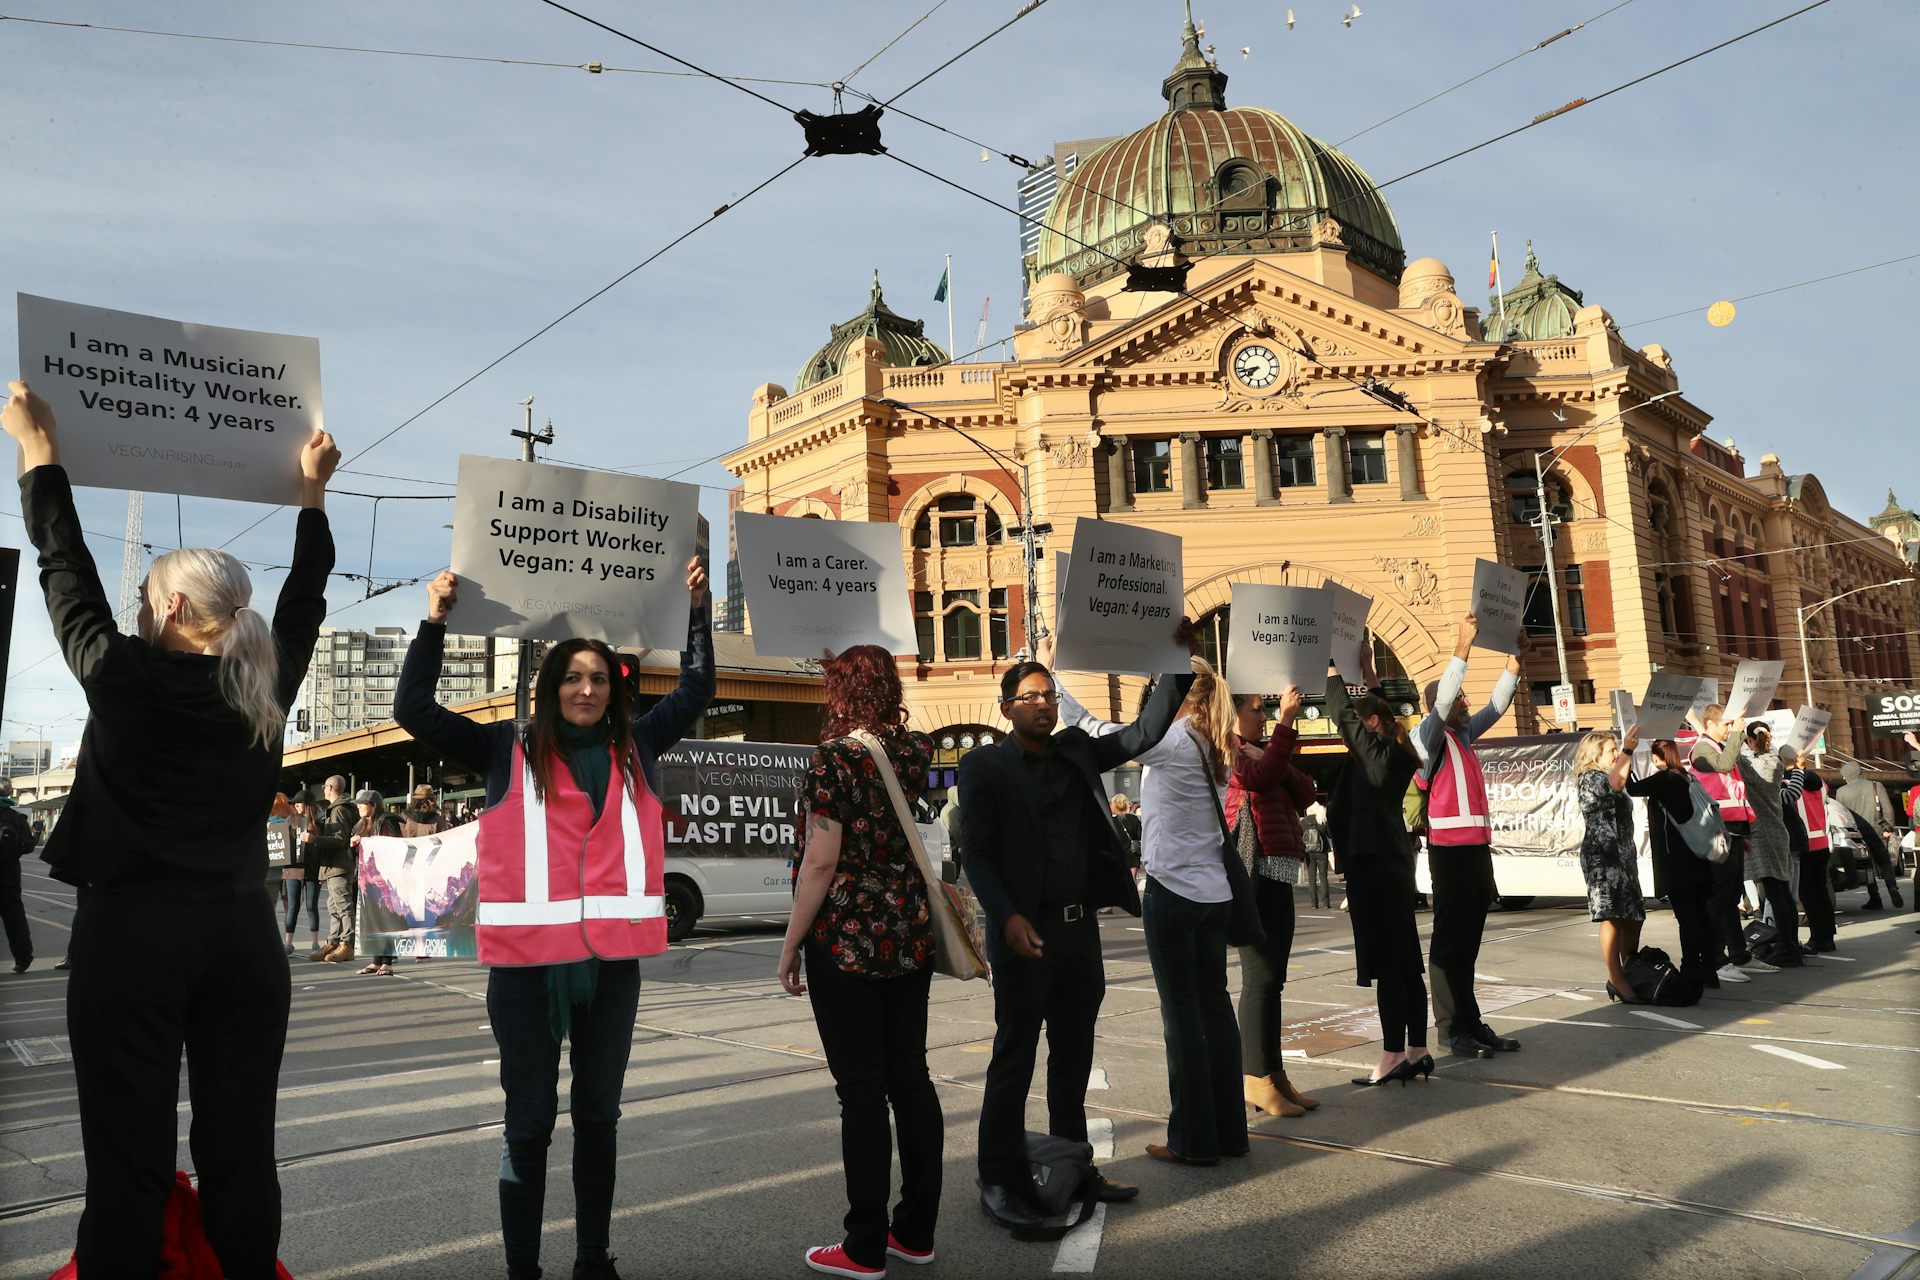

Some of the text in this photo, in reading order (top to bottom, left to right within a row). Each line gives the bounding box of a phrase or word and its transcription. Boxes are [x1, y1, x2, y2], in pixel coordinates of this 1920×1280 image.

[69, 331, 286, 381] I am a Musician/
[44, 355, 302, 410] Hospitality Worker.
[79, 390, 275, 433] Vegan: 4 years
[498, 490, 670, 532] I am a Disability
[490, 519, 666, 555] Support Worker.
[499, 548, 655, 581] Vegan: 4 years
[776, 552, 868, 570] I am a Carer.
[1089, 547, 1176, 577] I am a Marketing
[768, 574, 877, 596] Vegan: 4 years
[1097, 573, 1168, 595] Professional.
[1089, 597, 1170, 620] Vegan: 4 years
[1258, 613, 1318, 627] I am a Nurse.
[1252, 630, 1318, 646] Vegan: 2 years
[1880, 694, 1920, 713] SOS
[700, 771, 803, 789] VEGANRISING
[680, 794, 721, 816] NO
[729, 795, 787, 818] EVIL
[667, 821, 736, 844] LAST
[763, 876, 779, 886] Car
